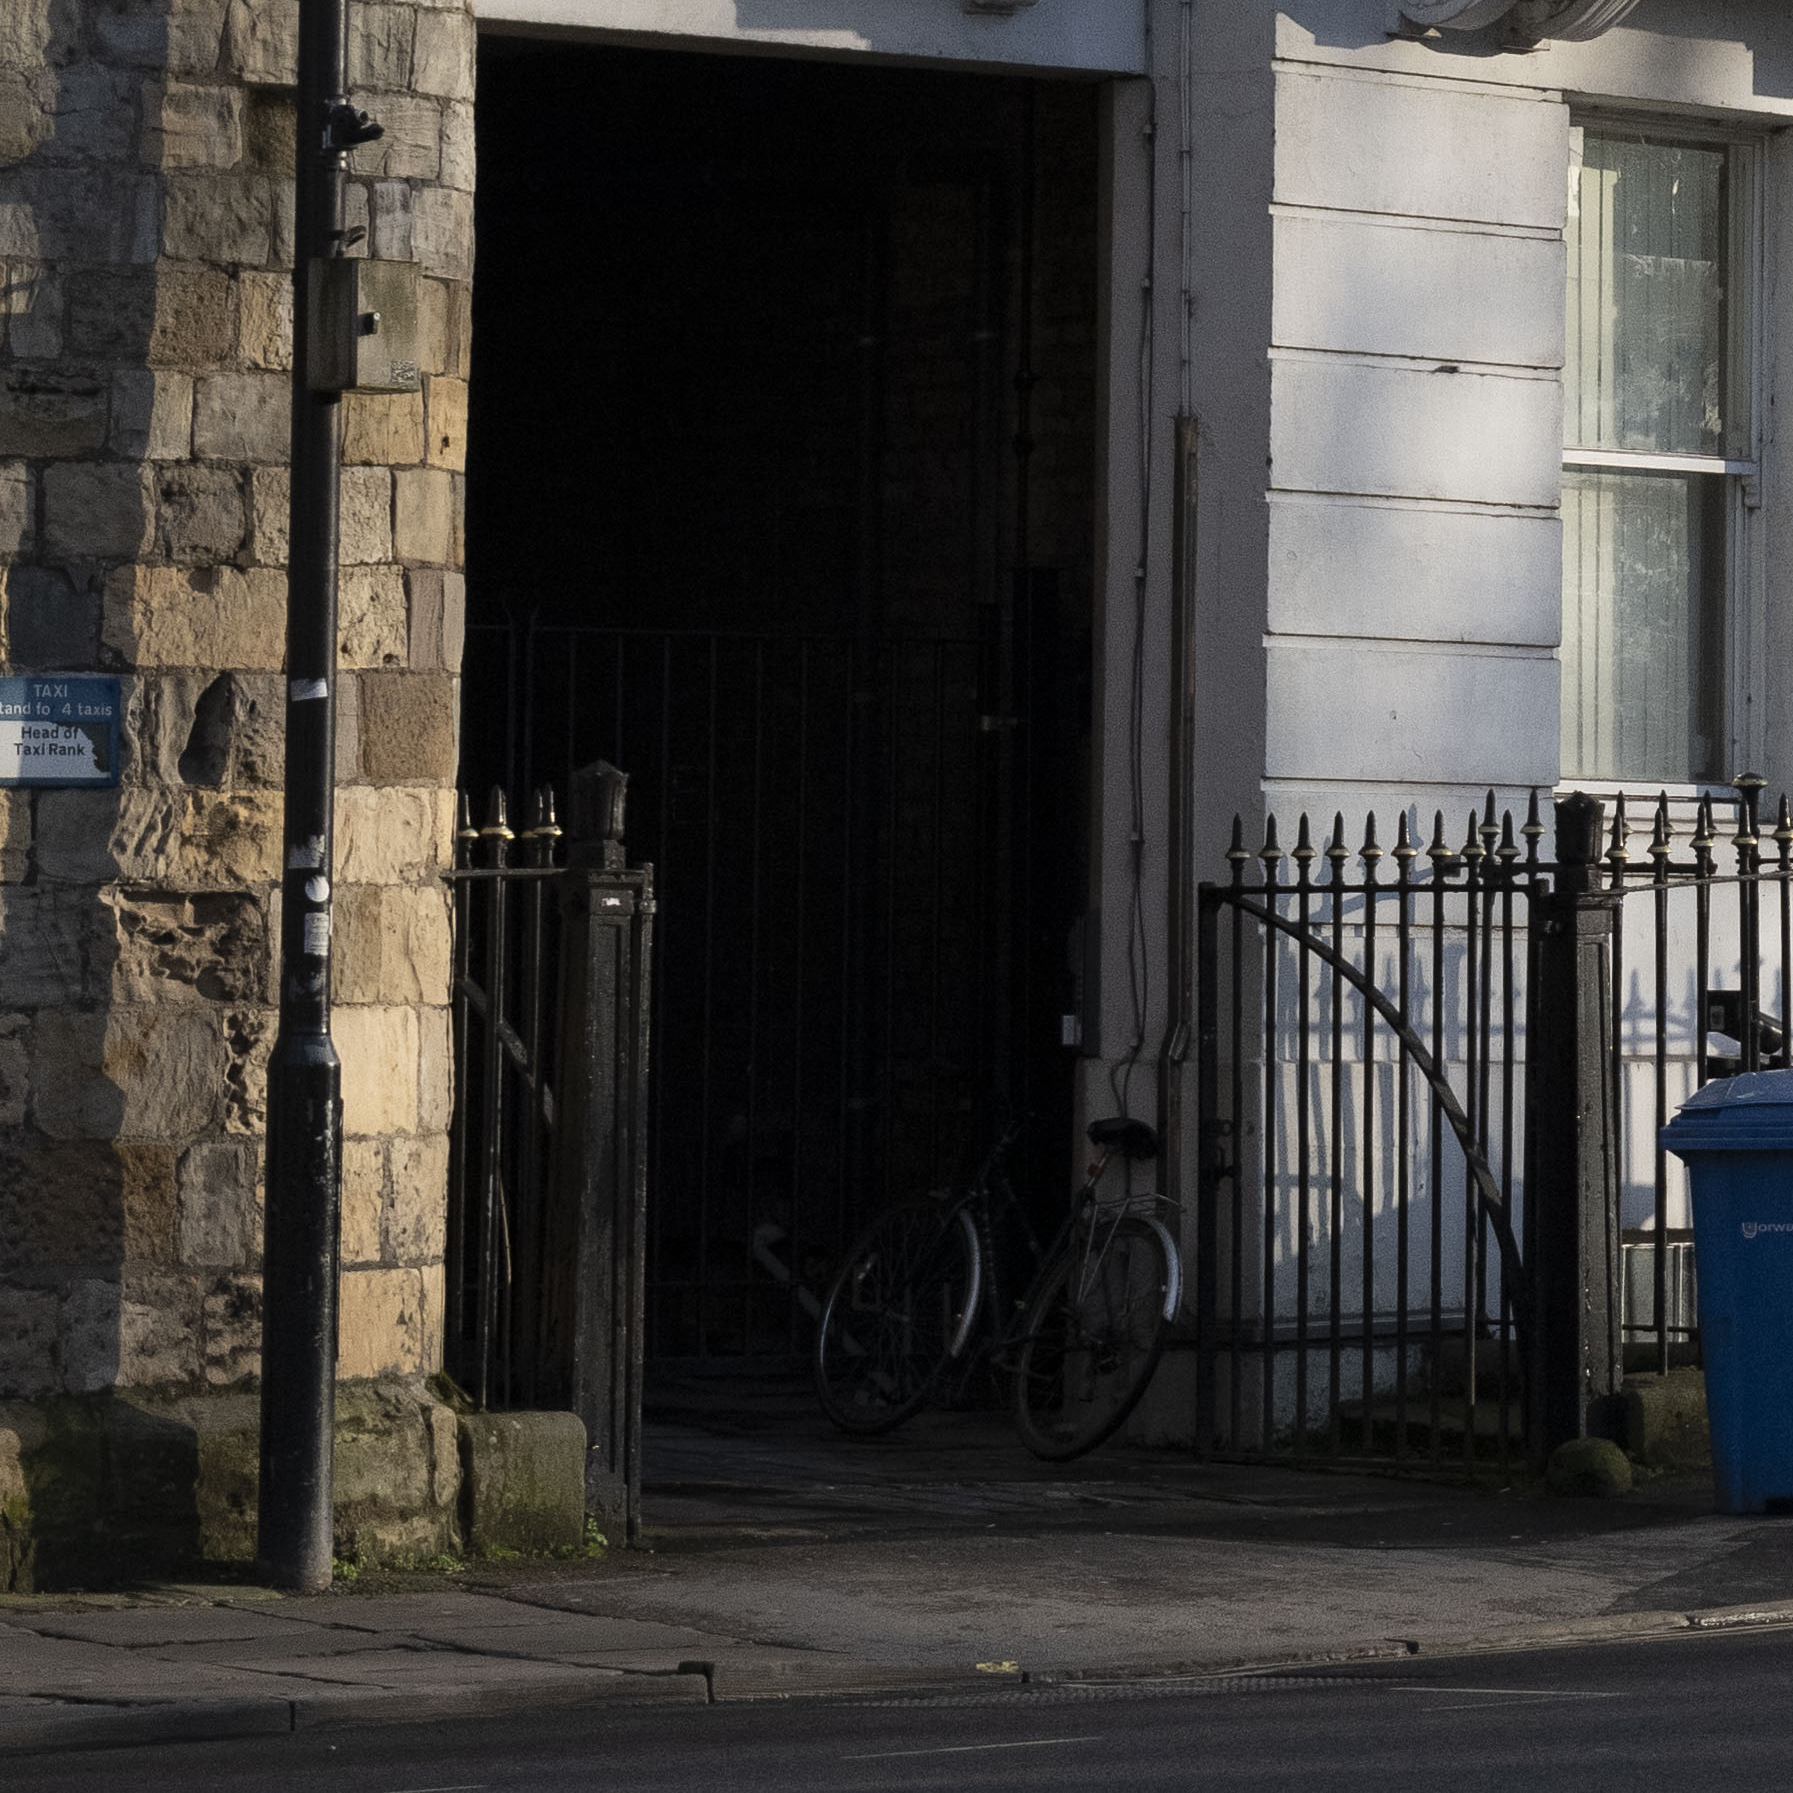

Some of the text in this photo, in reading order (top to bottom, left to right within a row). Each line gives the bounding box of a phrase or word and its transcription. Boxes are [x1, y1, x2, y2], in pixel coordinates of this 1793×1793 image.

[34, 684, 67, 697] TAXI
[36, 702, 51, 715] fo
[61, 703, 72, 715] 4
[78, 703, 112, 715] taxis
[21, 725, 79, 739] Head of
[14, 743, 86, 756] Taxi Rank
